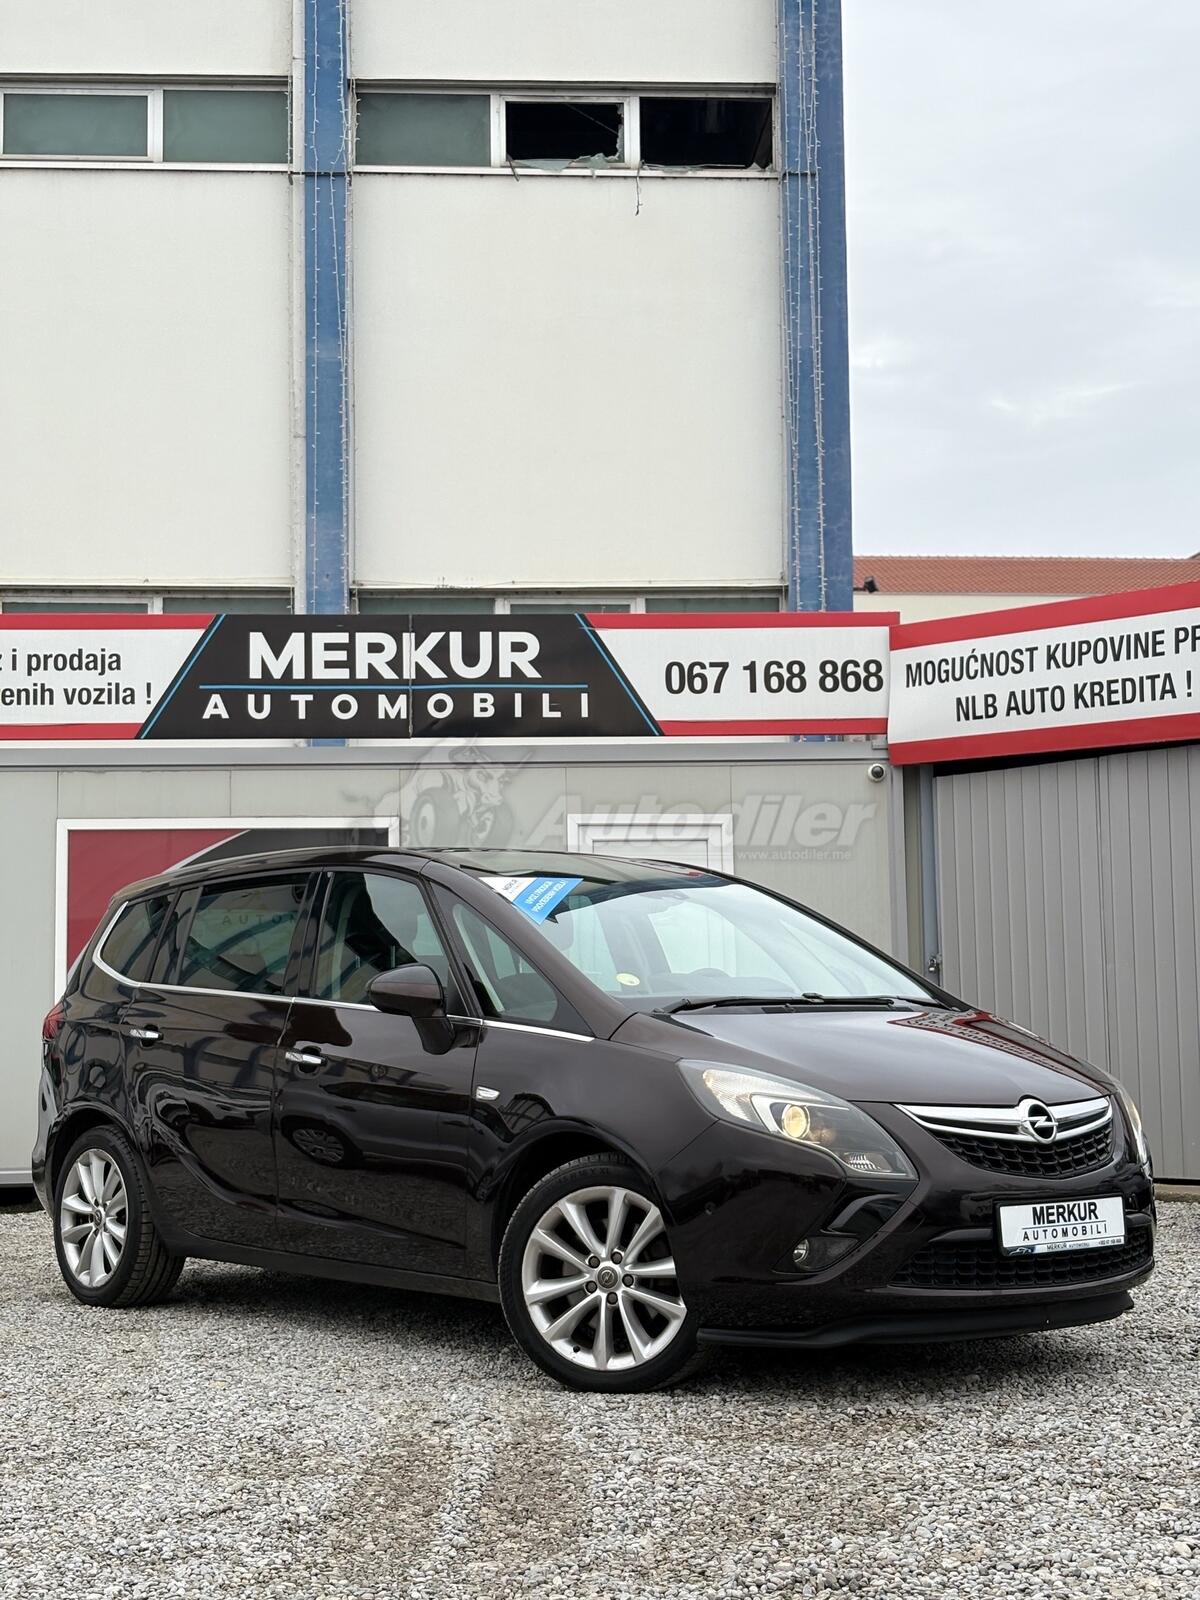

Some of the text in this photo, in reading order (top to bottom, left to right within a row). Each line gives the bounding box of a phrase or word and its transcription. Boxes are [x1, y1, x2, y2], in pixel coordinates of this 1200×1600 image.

[11, 648, 17, 671] i
[26, 648, 122, 676] prodaja
[249, 631, 541, 681] MERKUR
[905, 646, 1039, 688] MOGUĆNOST
[1046, 629, 1166, 671] KUPOVINE
[664, 658, 884, 695] 067 168 868
[0, 682, 152, 706] enih vozila !
[202, 691, 590, 720] AUTOMOBILI
[955, 670, 1192, 722] NLB AUTO KREDITA !
[1031, 1201, 1099, 1226] MERKUR
[1022, 1223, 1108, 1242] AUTOMOBILI
